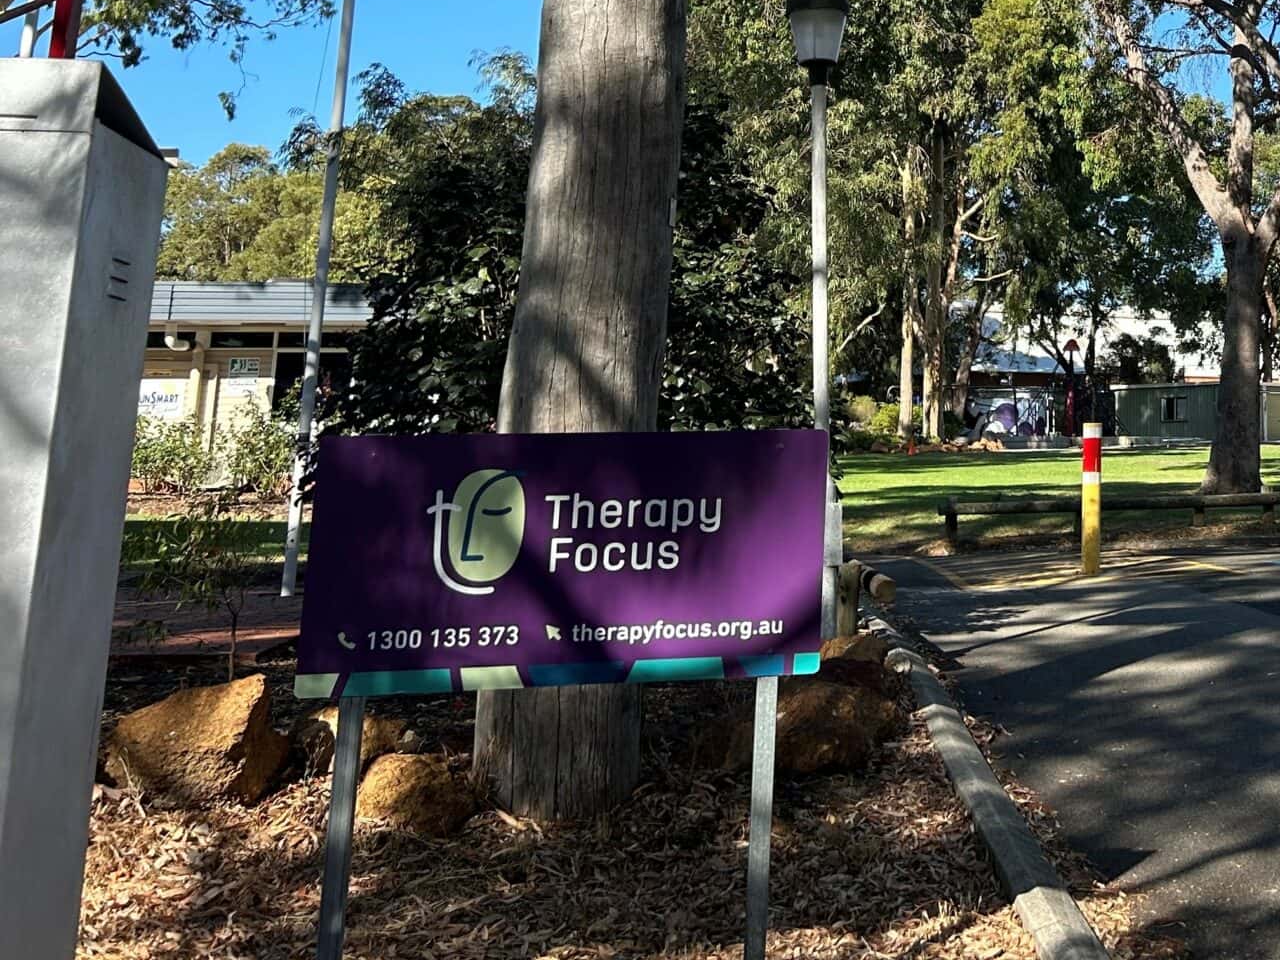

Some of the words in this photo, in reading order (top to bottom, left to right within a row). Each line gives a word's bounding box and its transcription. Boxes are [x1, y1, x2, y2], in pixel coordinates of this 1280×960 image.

[545, 493, 722, 533] Therapy
[549, 538, 680, 573] Focus
[367, 630, 421, 651] 1300
[431, 628, 471, 648] 135
[478, 626, 520, 646] 373
[572, 619, 783, 644] therapyfocus.org.au
